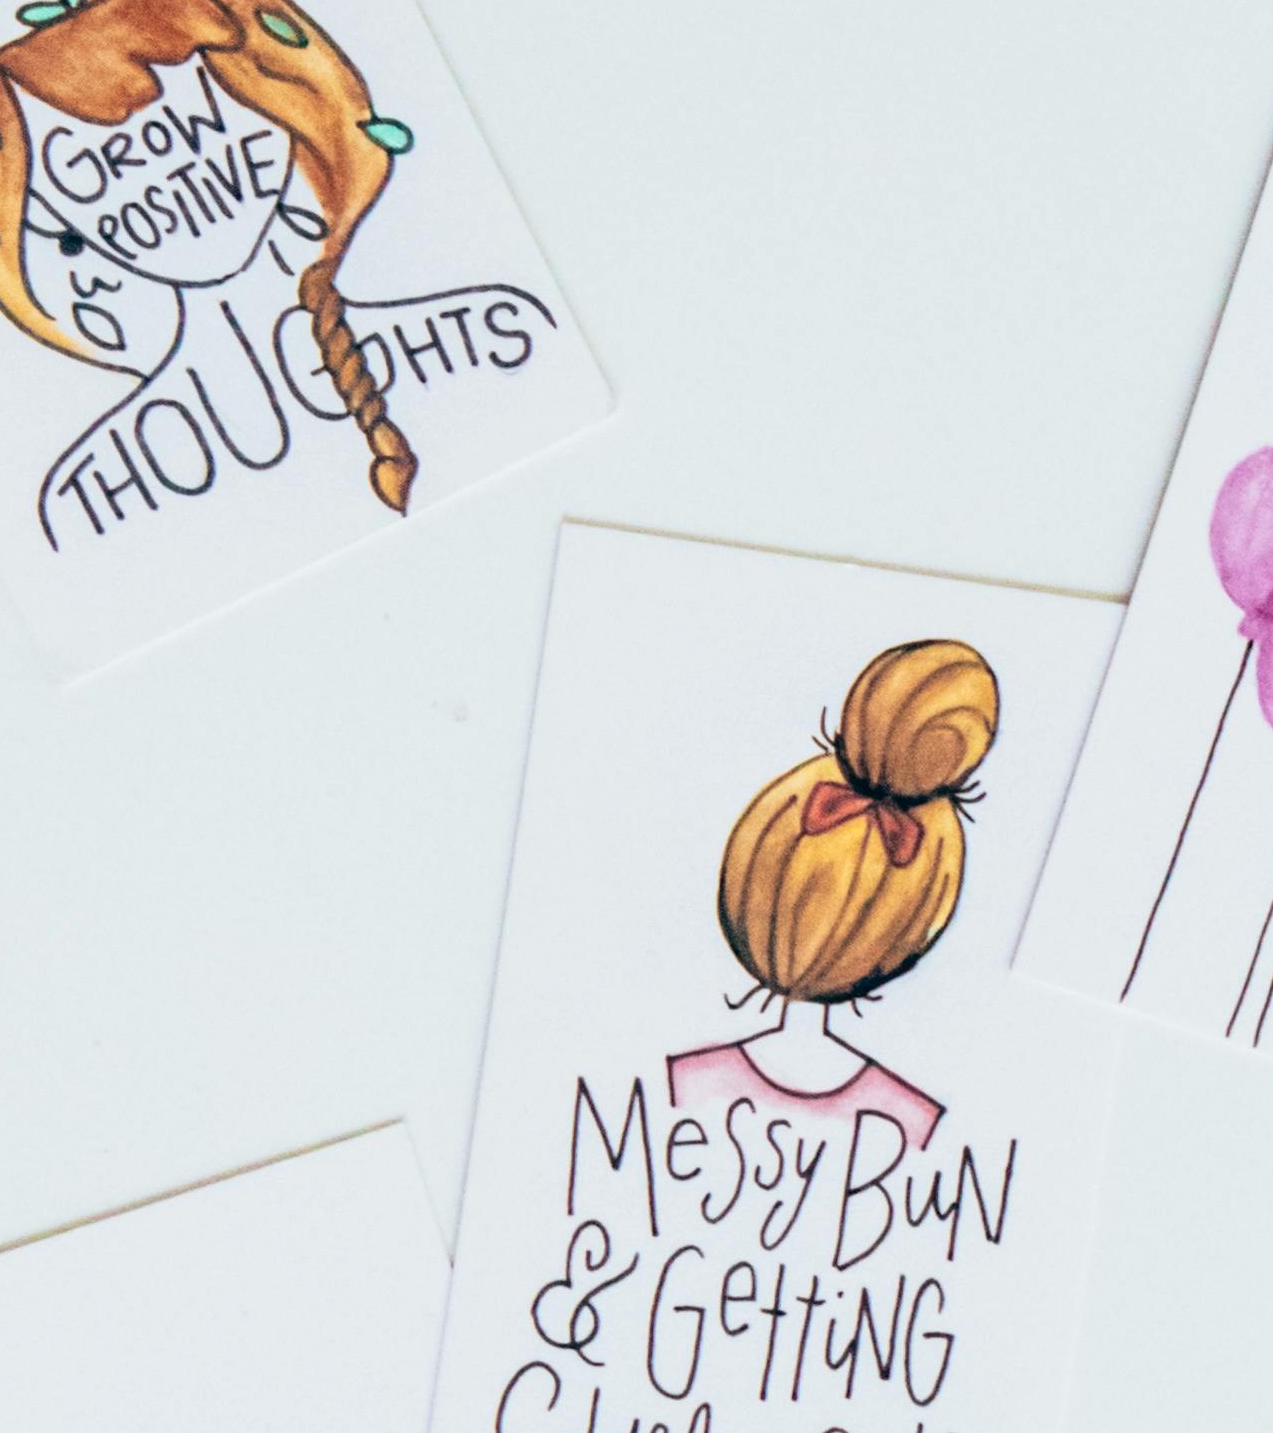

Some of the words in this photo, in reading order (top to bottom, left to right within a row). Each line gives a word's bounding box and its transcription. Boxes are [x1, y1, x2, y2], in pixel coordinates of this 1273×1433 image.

[42, 64, 228, 204] GROW
[98, 128, 279, 260] POSITIVE
[57, 300, 533, 535] THOUGHTS
[530, 1219, 640, 1366] &
